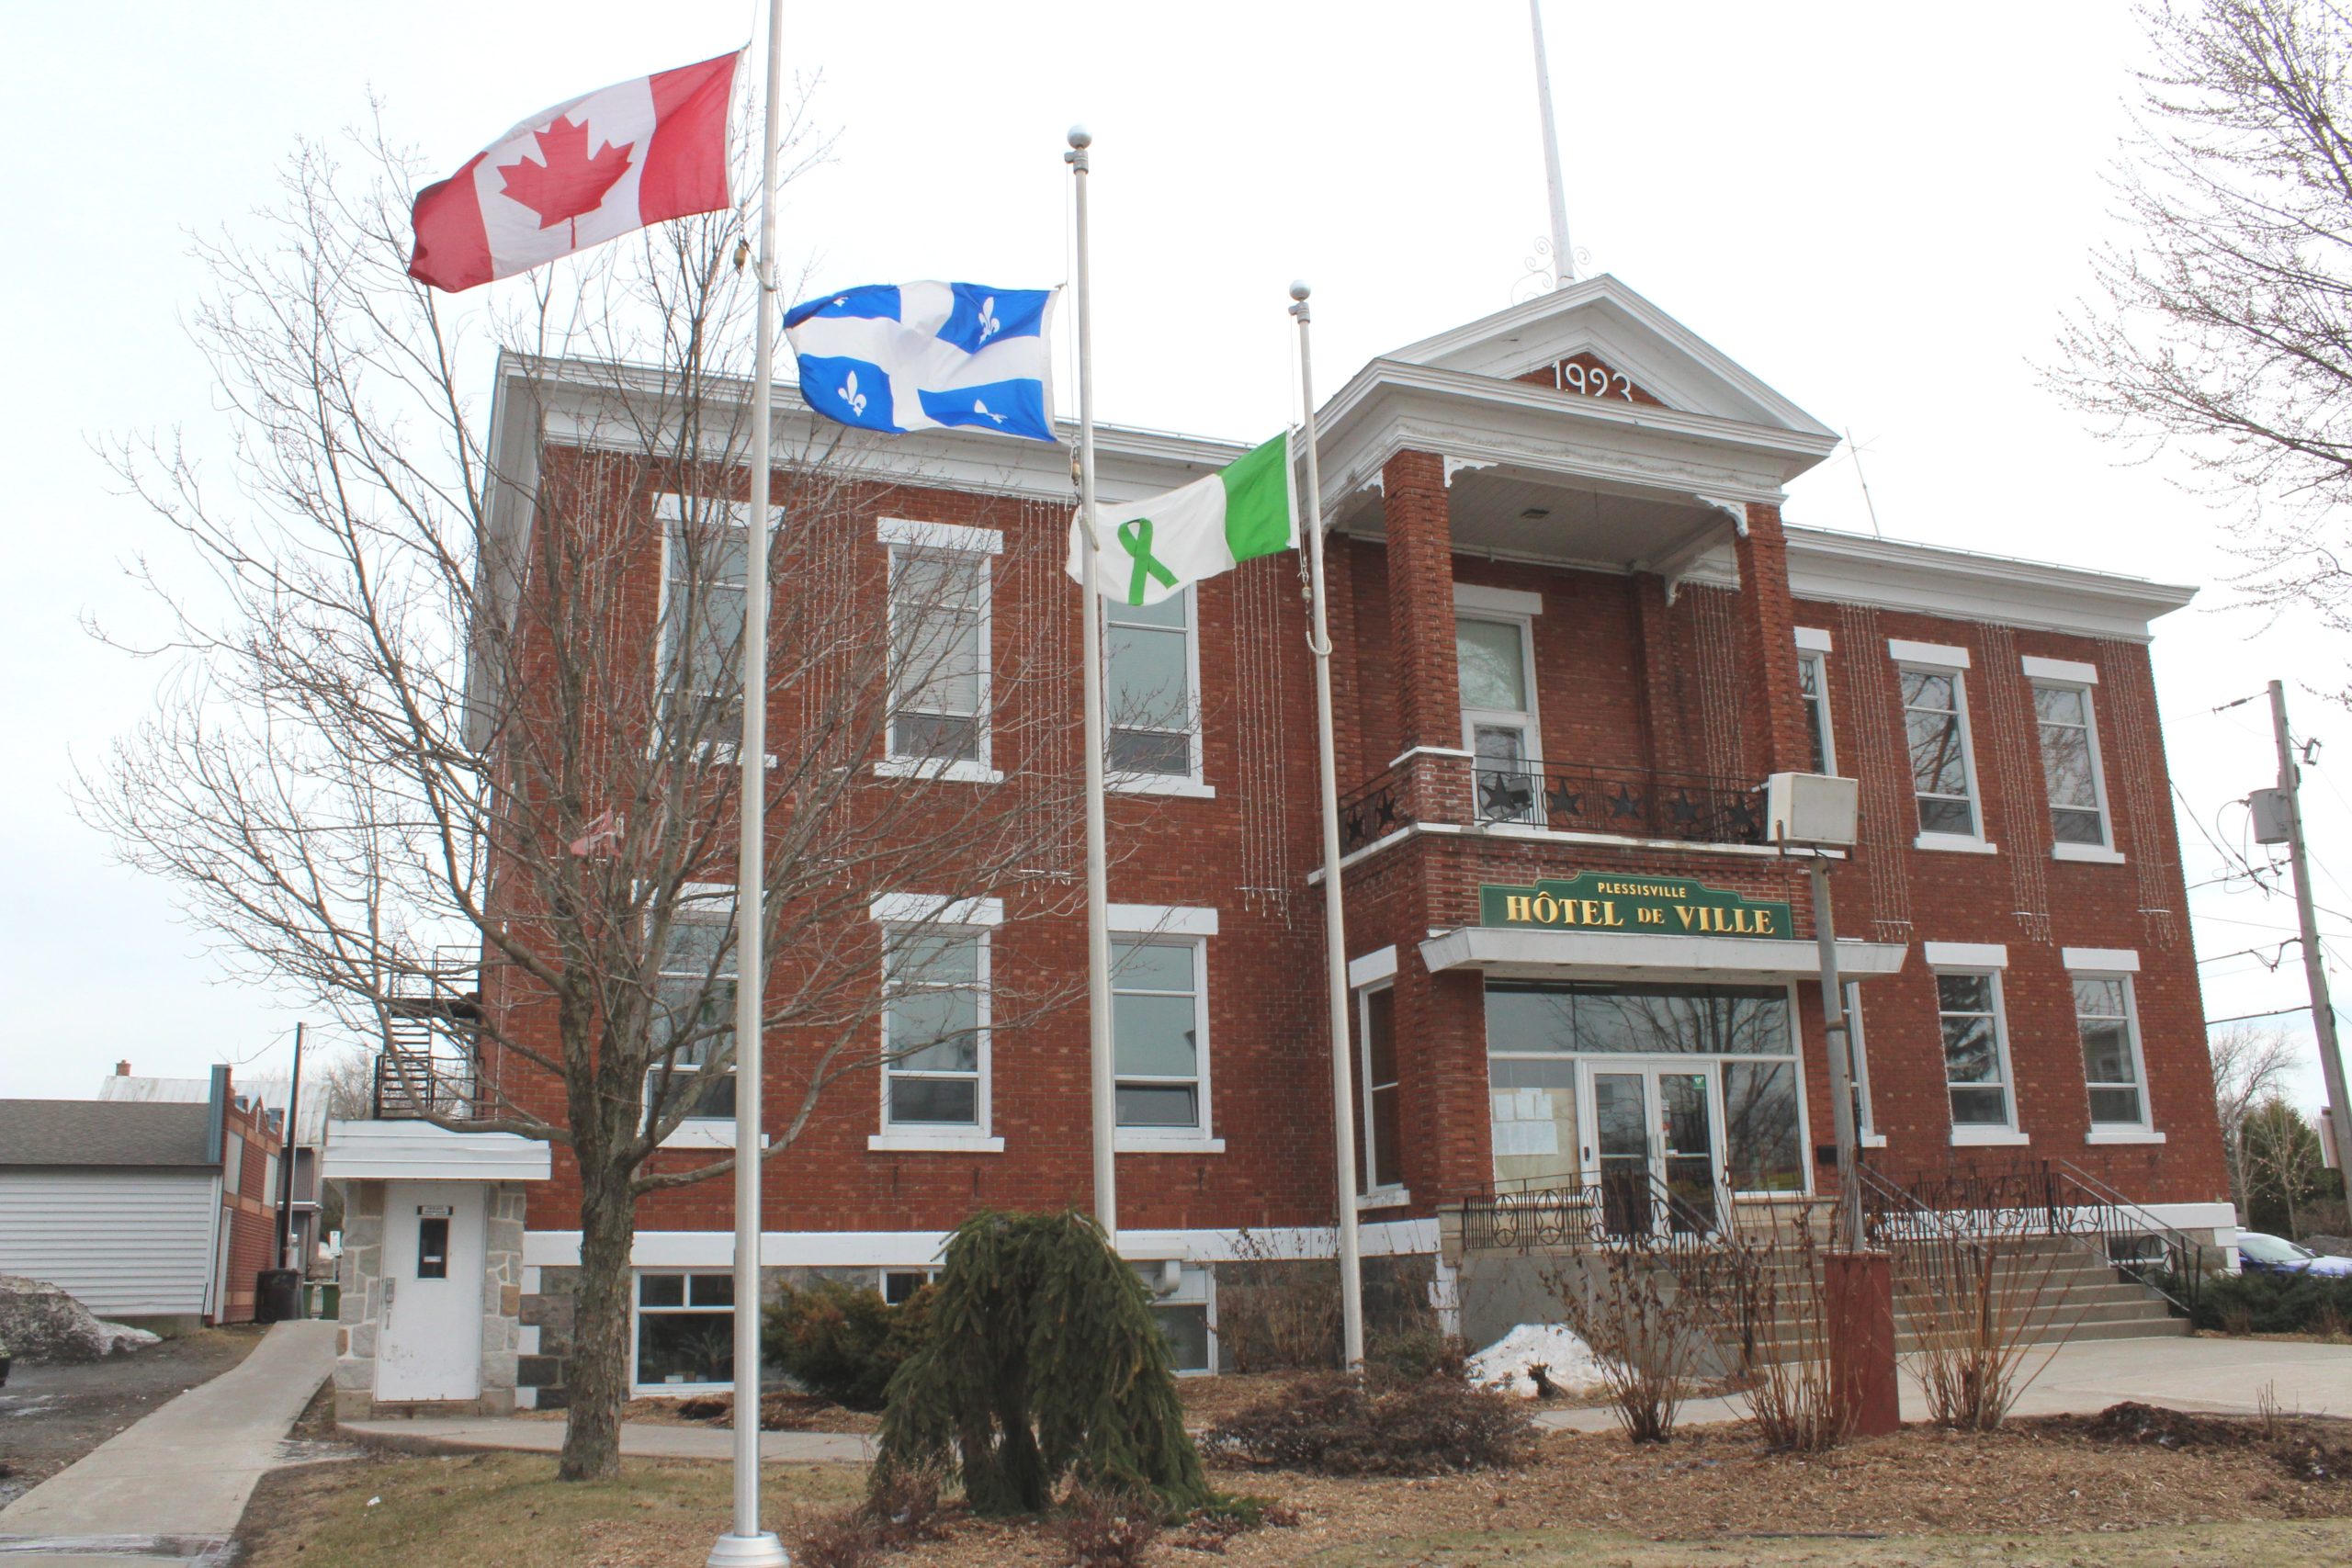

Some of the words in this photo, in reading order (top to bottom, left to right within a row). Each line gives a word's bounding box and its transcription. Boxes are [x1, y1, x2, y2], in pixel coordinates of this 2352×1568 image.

[1598, 882, 1687, 898] PLESSISVILLE
[1506, 891, 1624, 927] HÔTEL
[1637, 907, 1666, 924] DE
[1673, 905, 1775, 934] VILLE
